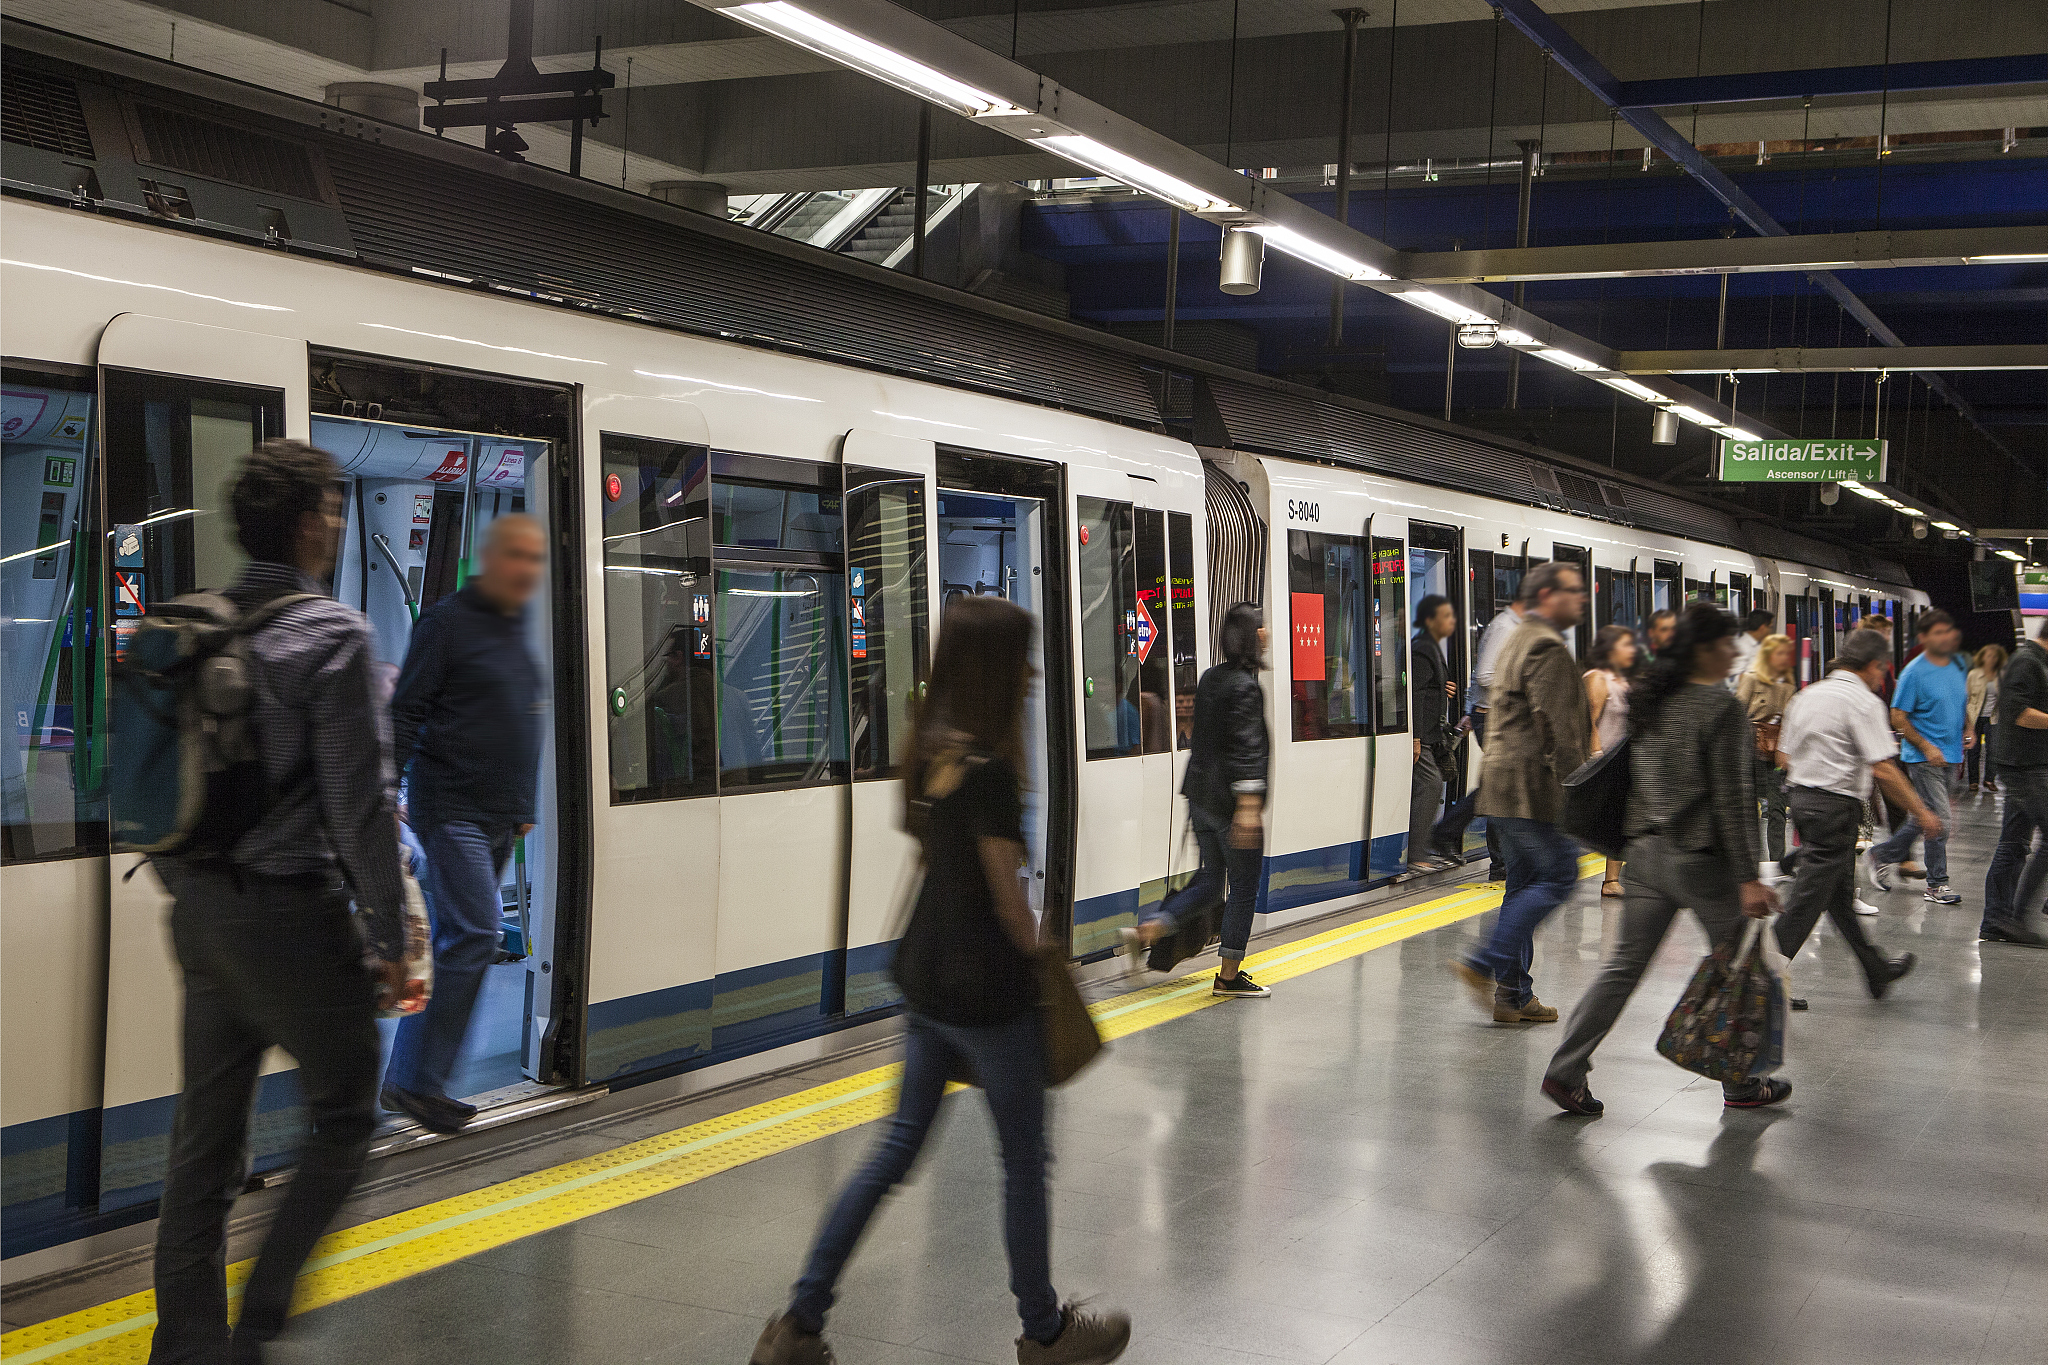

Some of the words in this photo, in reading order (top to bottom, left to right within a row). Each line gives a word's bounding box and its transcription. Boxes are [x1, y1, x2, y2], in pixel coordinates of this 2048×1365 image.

[1732, 442, 1855, 462] Salida/Exit
[437, 466, 466, 475] ALARMA
[1766, 469, 1819, 480] Ascensor
[1828, 469, 1846, 480] Lift
[1288, 498, 1320, 523] S-8040
